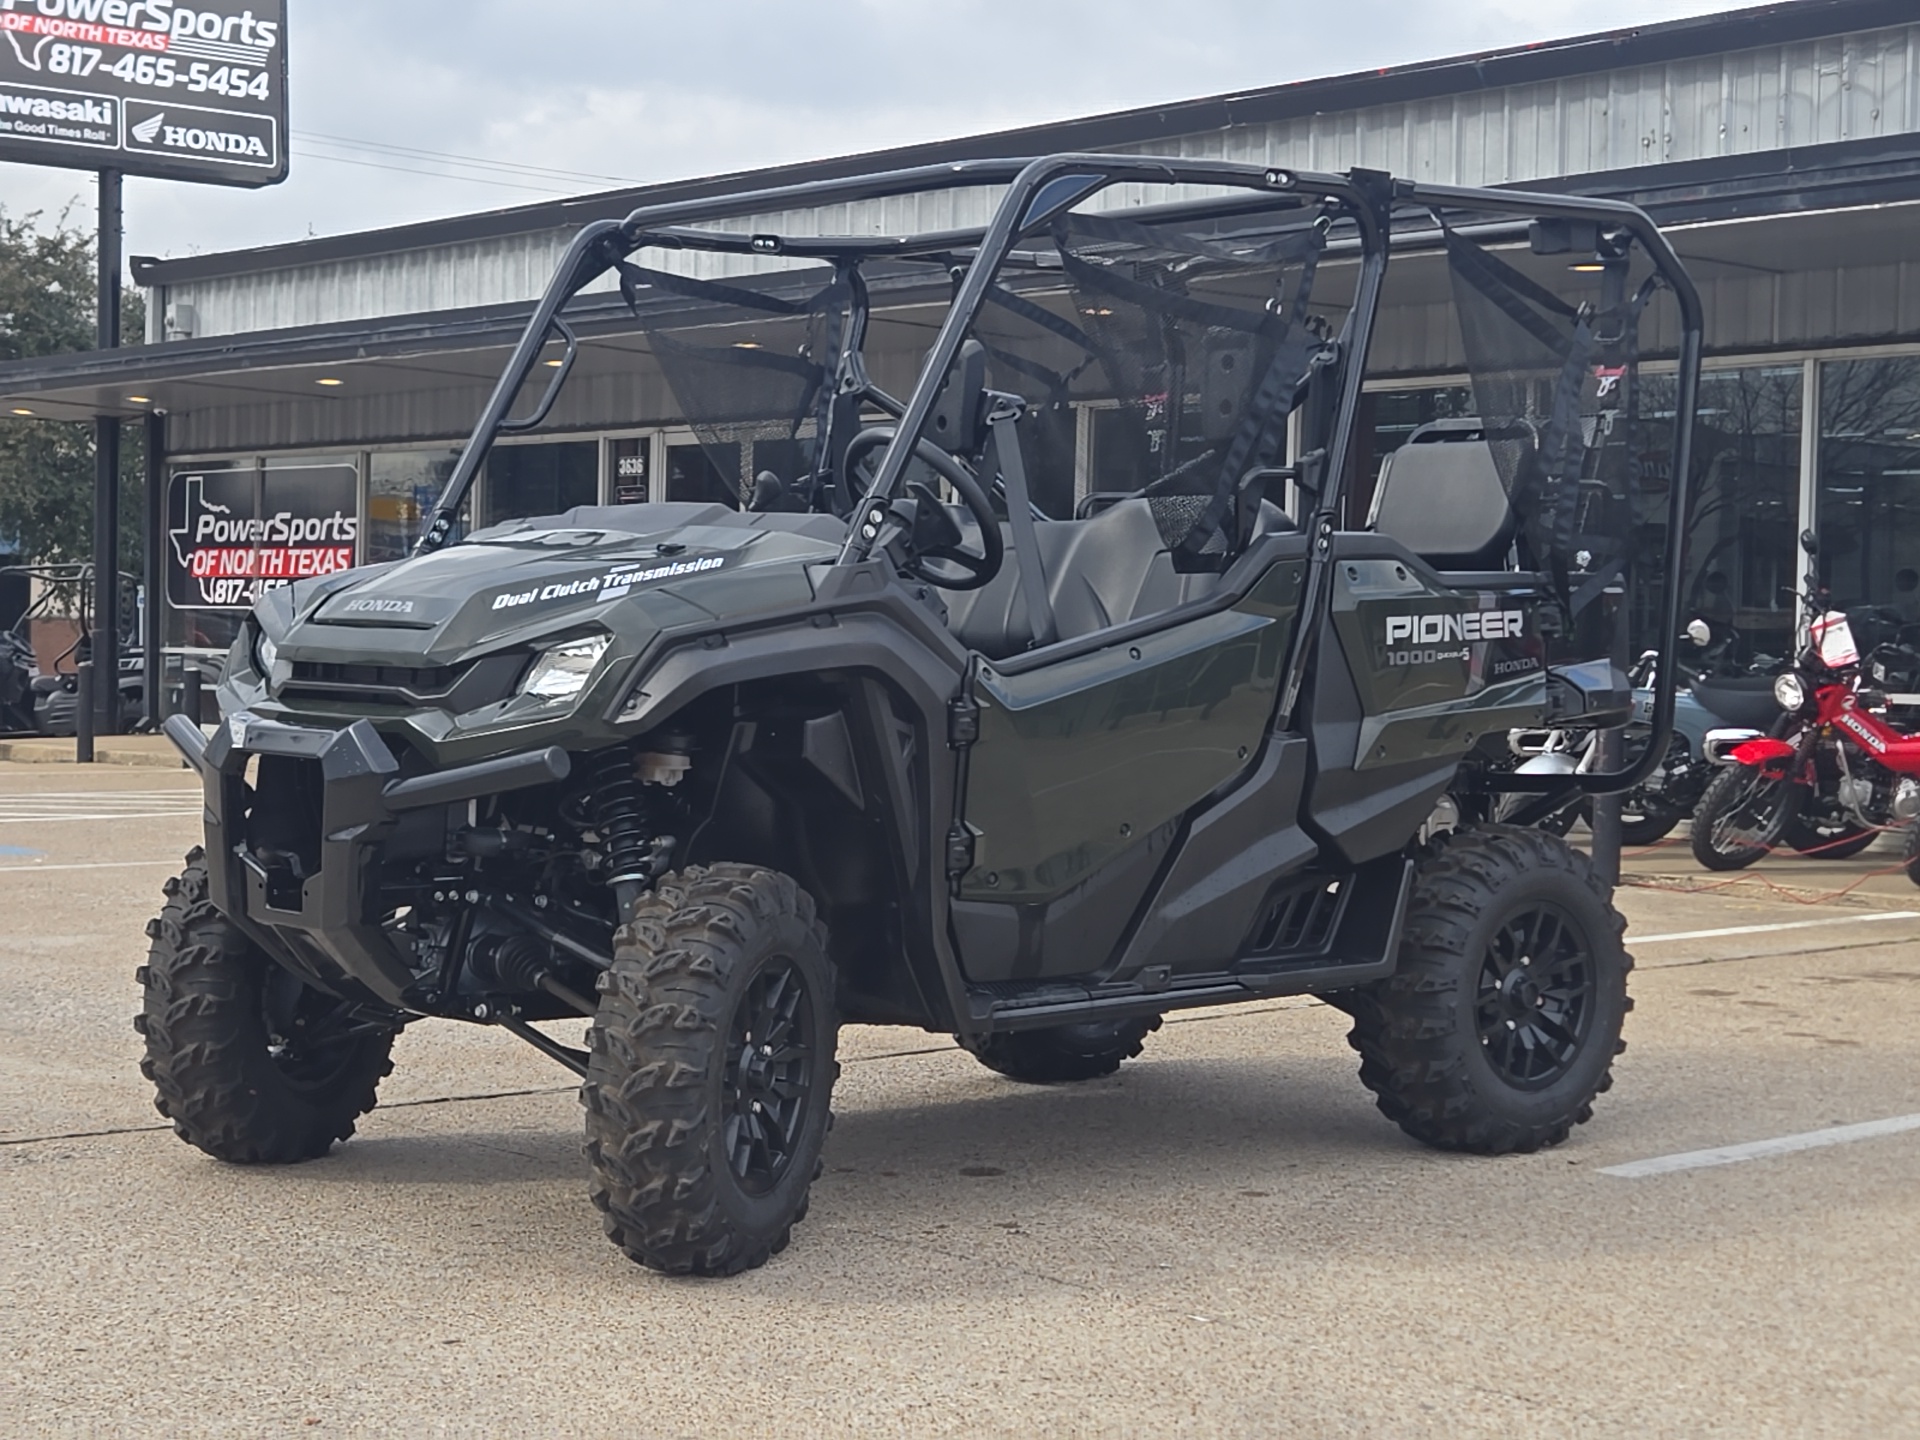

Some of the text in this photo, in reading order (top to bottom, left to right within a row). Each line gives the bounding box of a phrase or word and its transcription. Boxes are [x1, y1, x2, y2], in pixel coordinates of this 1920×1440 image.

[2, 0, 277, 47] owerSports
[4, 13, 166, 50] OF NORTH TEXAS
[48, 43, 269, 100] 817-465-5454
[14, 120, 46, 134] Good
[47, 124, 81, 138] Times
[162, 125, 268, 156] HONDA
[195, 511, 357, 546] PowerSports
[193, 549, 219, 575] OF
[288, 548, 350, 574] TEXAS
[492, 557, 724, 610] Dual Clutch Transmission
[344, 599, 414, 613] HONDA
[1386, 610, 1523, 645] PIONEER
[1387, 650, 1436, 665] 1000
[1494, 658, 1539, 674] HONDA
[1841, 714, 1886, 753] HONDA
